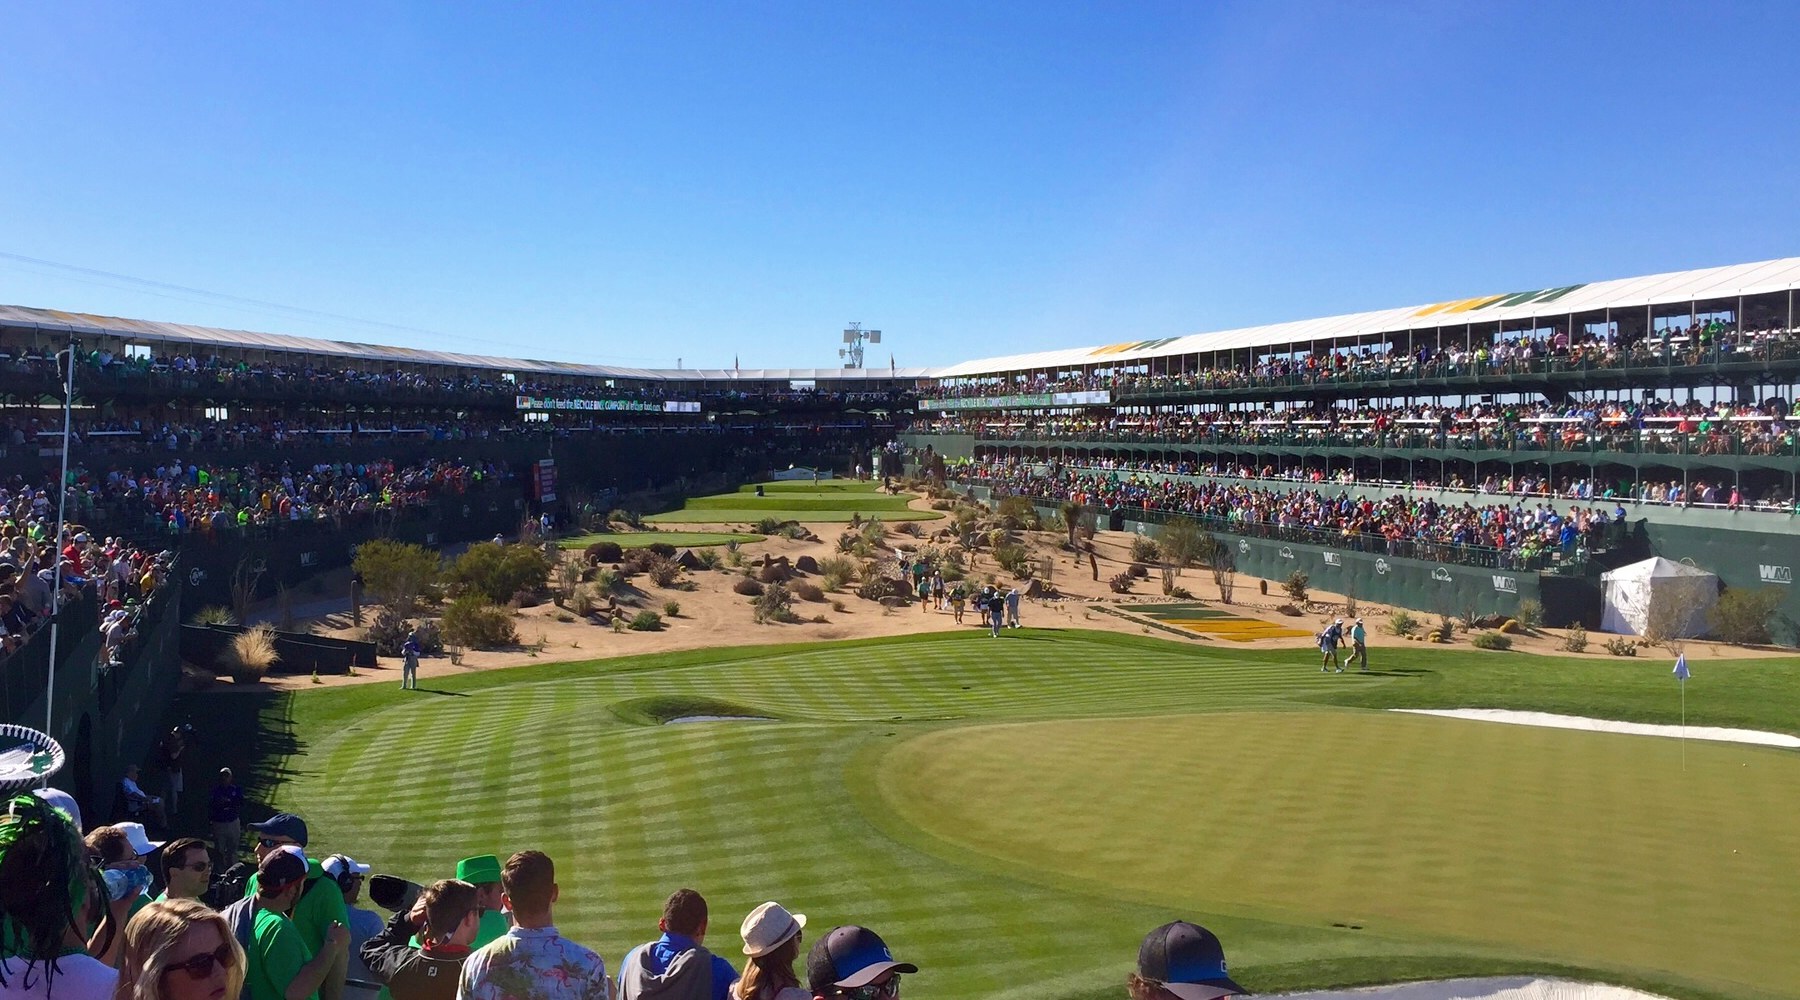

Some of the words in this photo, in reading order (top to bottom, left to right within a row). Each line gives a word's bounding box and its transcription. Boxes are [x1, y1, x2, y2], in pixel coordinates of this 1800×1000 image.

[574, 399, 593, 410] RECYCLE
[1759, 564, 1792, 581] WM
[1492, 575, 1517, 591] WM
[427, 966, 438, 977] FJ
